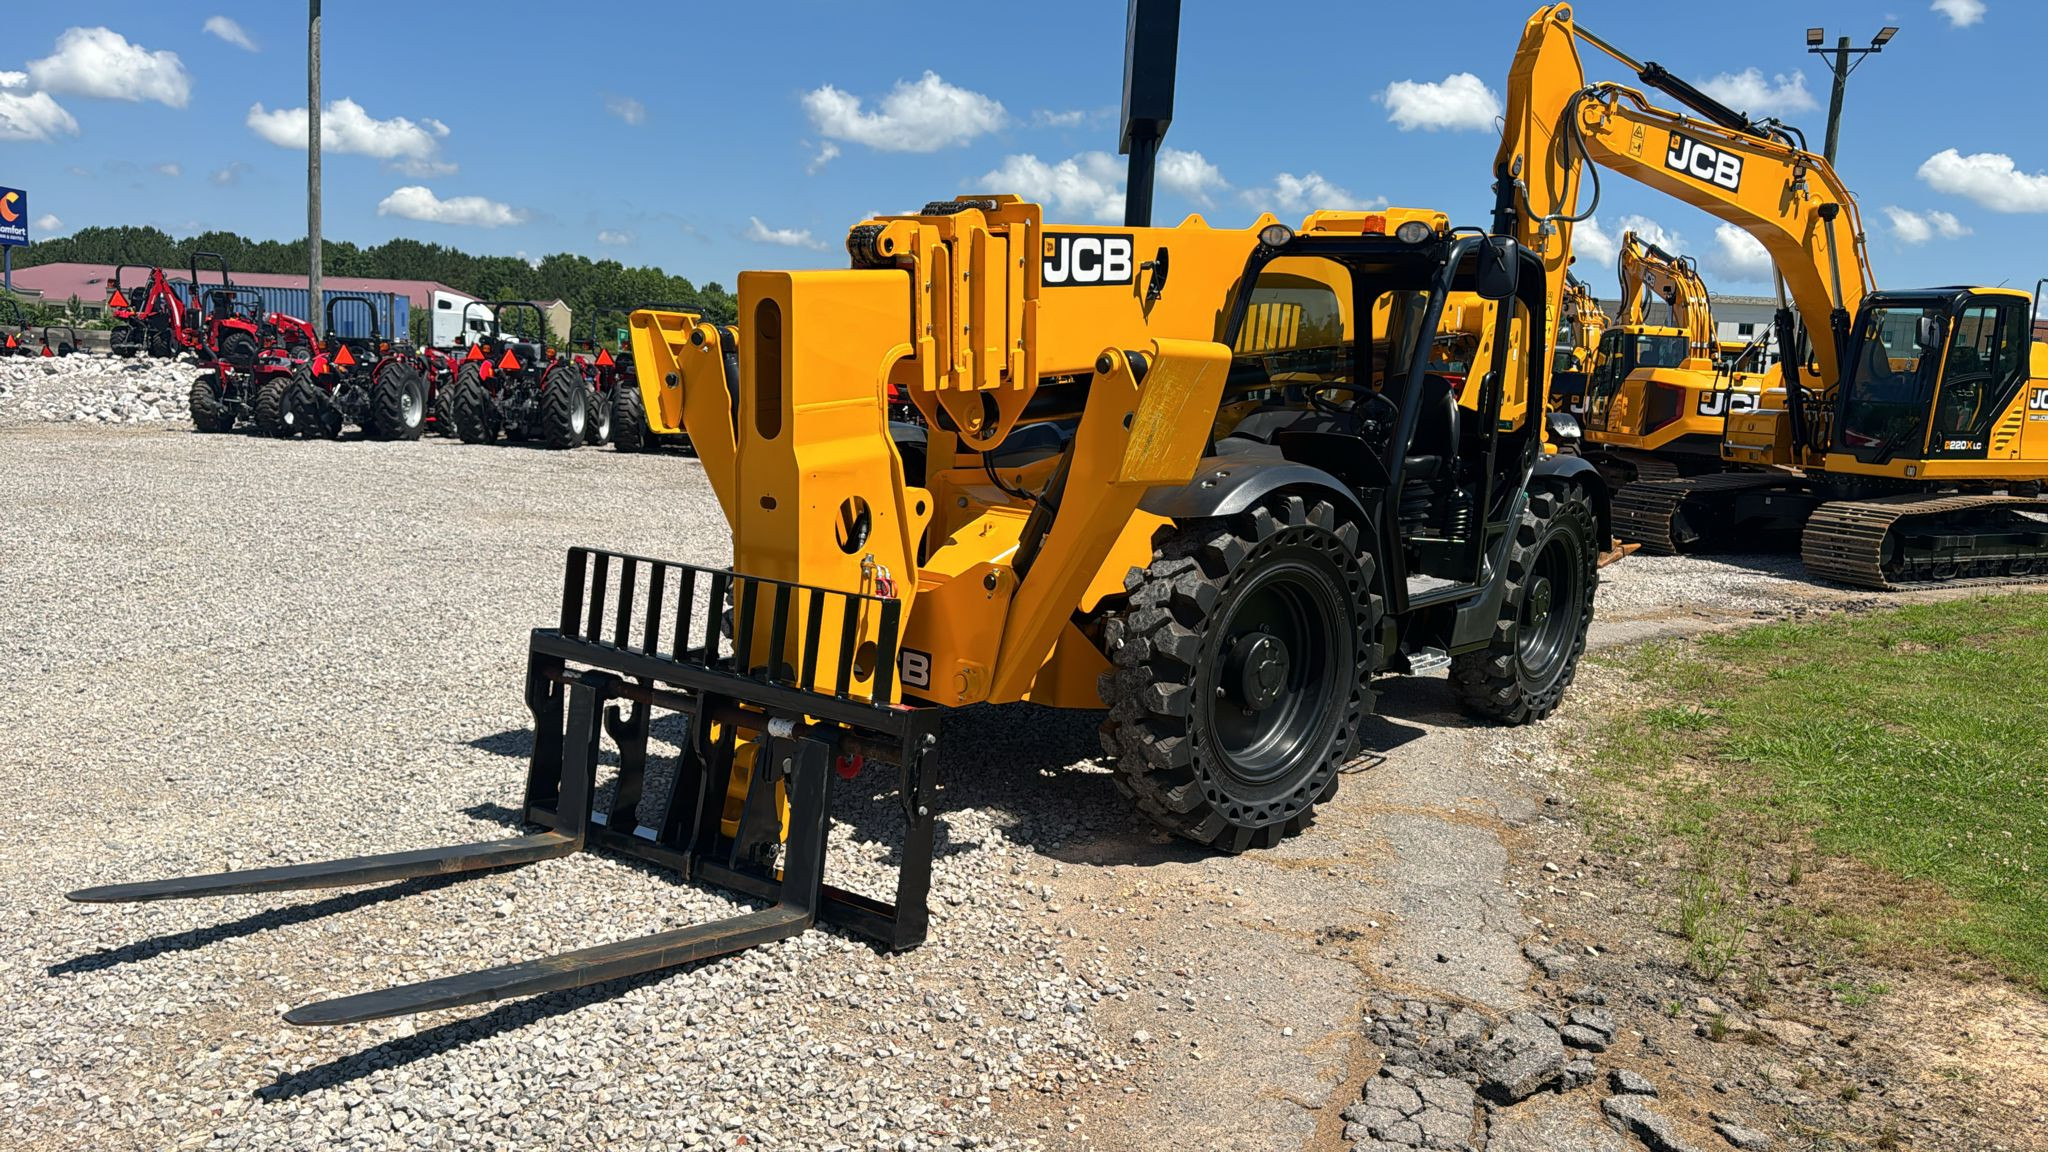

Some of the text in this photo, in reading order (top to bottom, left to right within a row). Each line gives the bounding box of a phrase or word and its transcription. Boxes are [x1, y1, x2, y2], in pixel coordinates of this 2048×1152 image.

[1667, 138, 1741, 189] JCB
[1043, 237, 1132, 283] JCB
[1700, 392, 1760, 416] JC
[2030, 389, 2048, 409] JC
